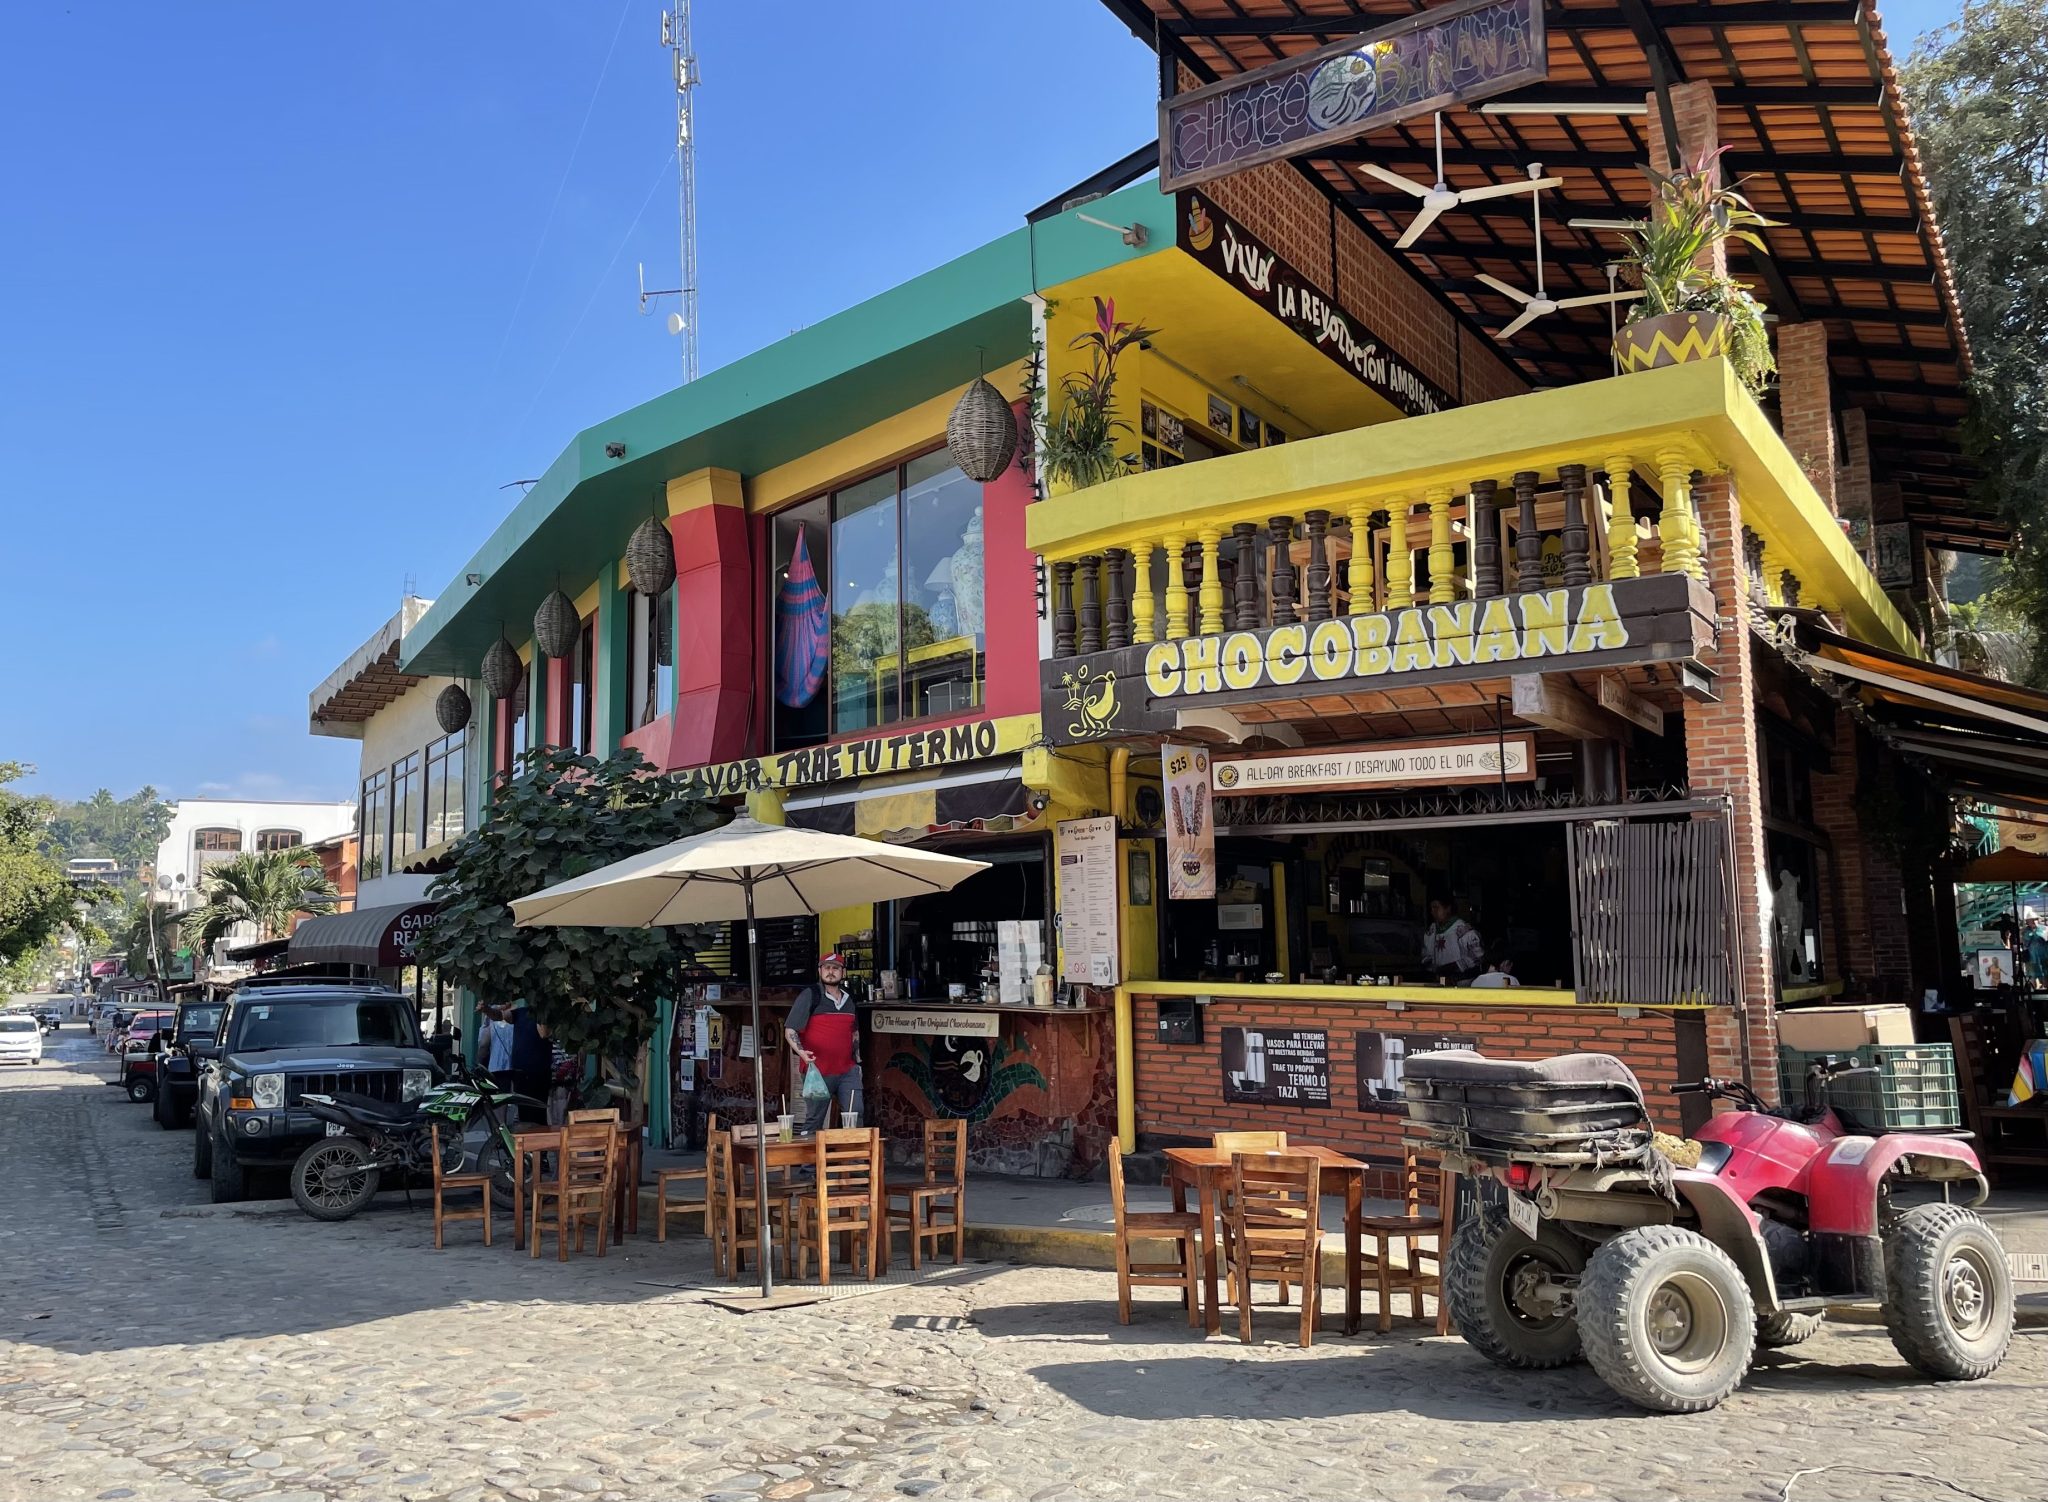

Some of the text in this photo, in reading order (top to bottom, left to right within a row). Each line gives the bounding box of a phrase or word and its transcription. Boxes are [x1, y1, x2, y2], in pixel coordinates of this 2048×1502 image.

[1174, 12, 1530, 170] CHOCO BANANA
[1221, 222, 1275, 293] VIVA
[1277, 283, 1297, 318] LA
[1145, 583, 1629, 697] CHOCOBANANA
[777, 748, 842, 787] TRAE
[848, 739, 882, 776] TU
[887, 720, 996, 770] TERMO
[1170, 756, 1187, 775] $25
[1246, 766, 1284, 781] ALL-DAY
[1288, 762, 1343, 779] BREAKFAST
[1346, 761, 1351, 775] /
[1355, 757, 1405, 775] DESAYUNO
[1409, 756, 1436, 771] TODO
[1440, 755, 1452, 769] EL
[1456, 753, 1474, 768] DIA
[895, 1016, 909, 1026] House
[911, 1019, 917, 1029] of
[928, 1018, 948, 1030] Original
[950, 1018, 986, 1028] Chocobanana
[1266, 1039, 1325, 1049] VASOS PARA LLEVAR
[1461, 1043, 1474, 1051] HAVE
[1272, 1063, 1315, 1073] TRAE TU PROPIO
[1288, 1072, 1327, 1087] TERMO Ó
[1277, 1086, 1299, 1099] TAZA
